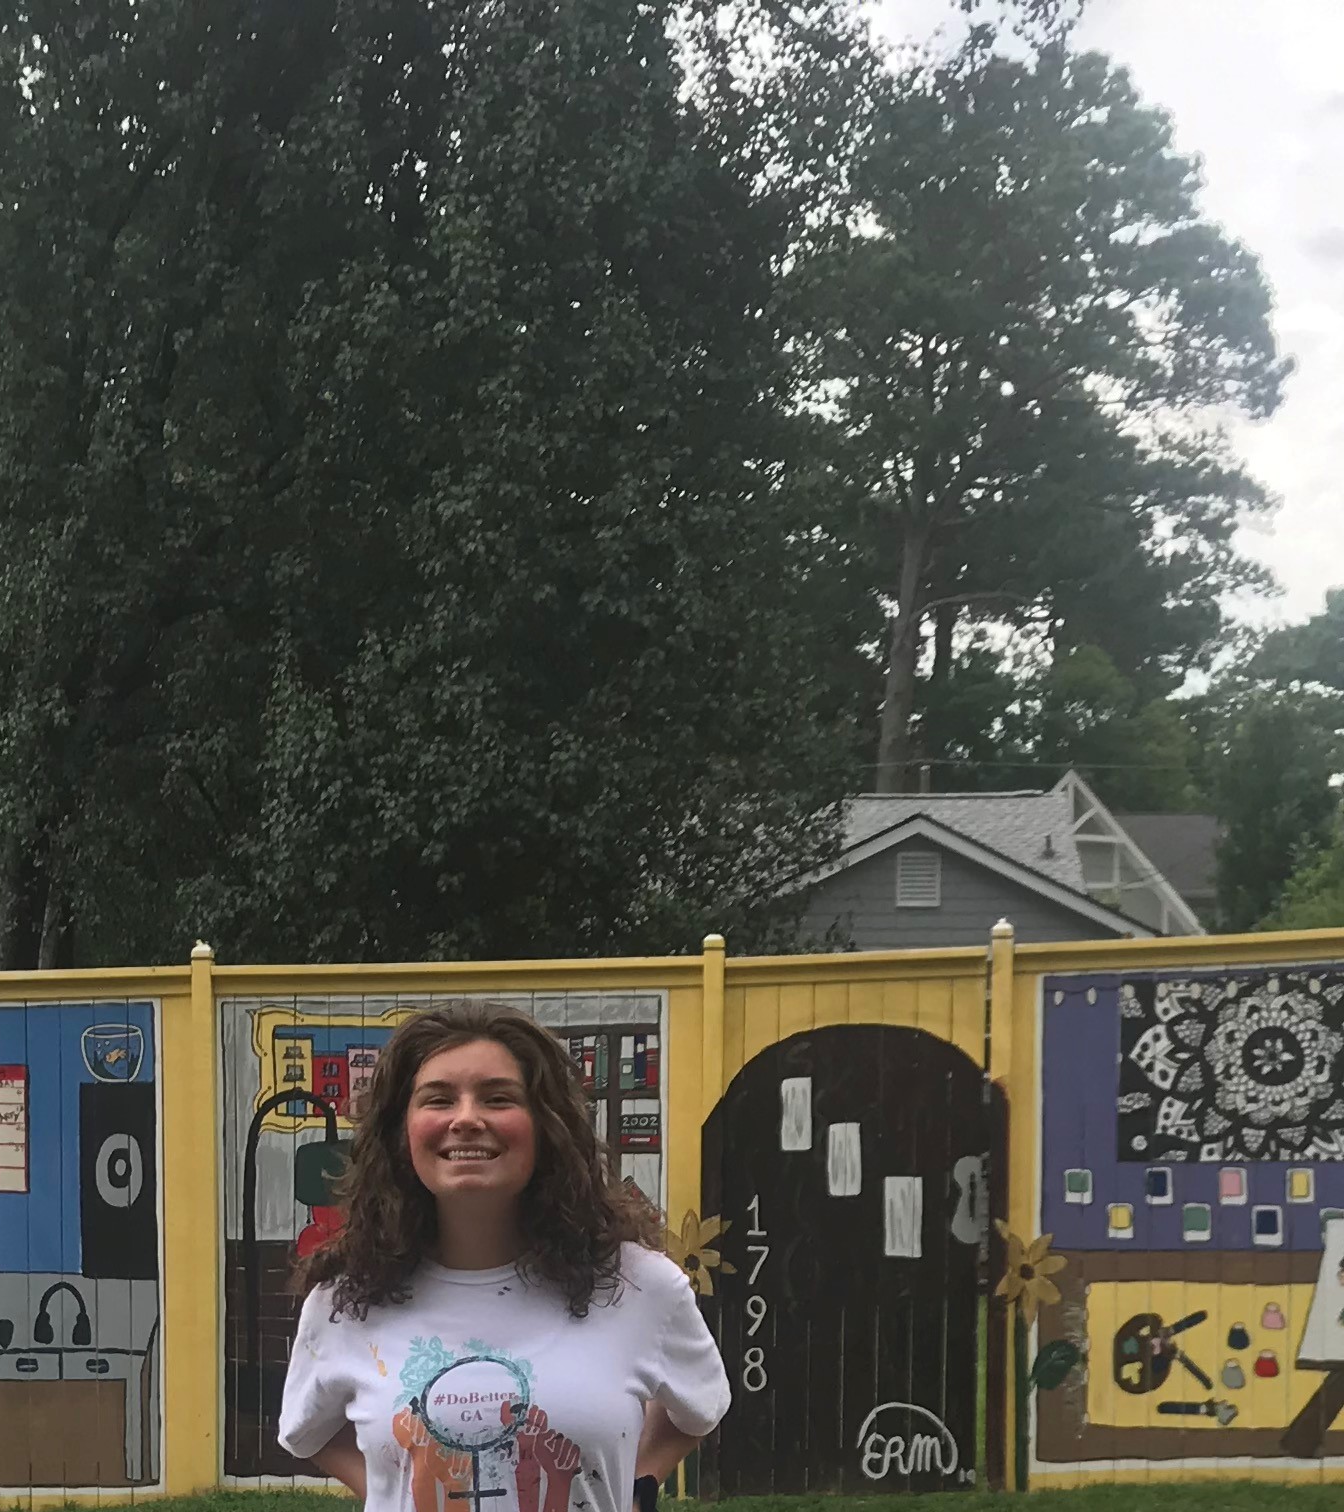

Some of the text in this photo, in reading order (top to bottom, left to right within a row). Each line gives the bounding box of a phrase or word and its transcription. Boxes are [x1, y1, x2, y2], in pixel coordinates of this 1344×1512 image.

[622, 1116, 659, 1127] 2002
[743, 1194, 770, 1392] 1798
[433, 1391, 517, 1406] #DoBetter
[460, 1410, 483, 1422] GA
